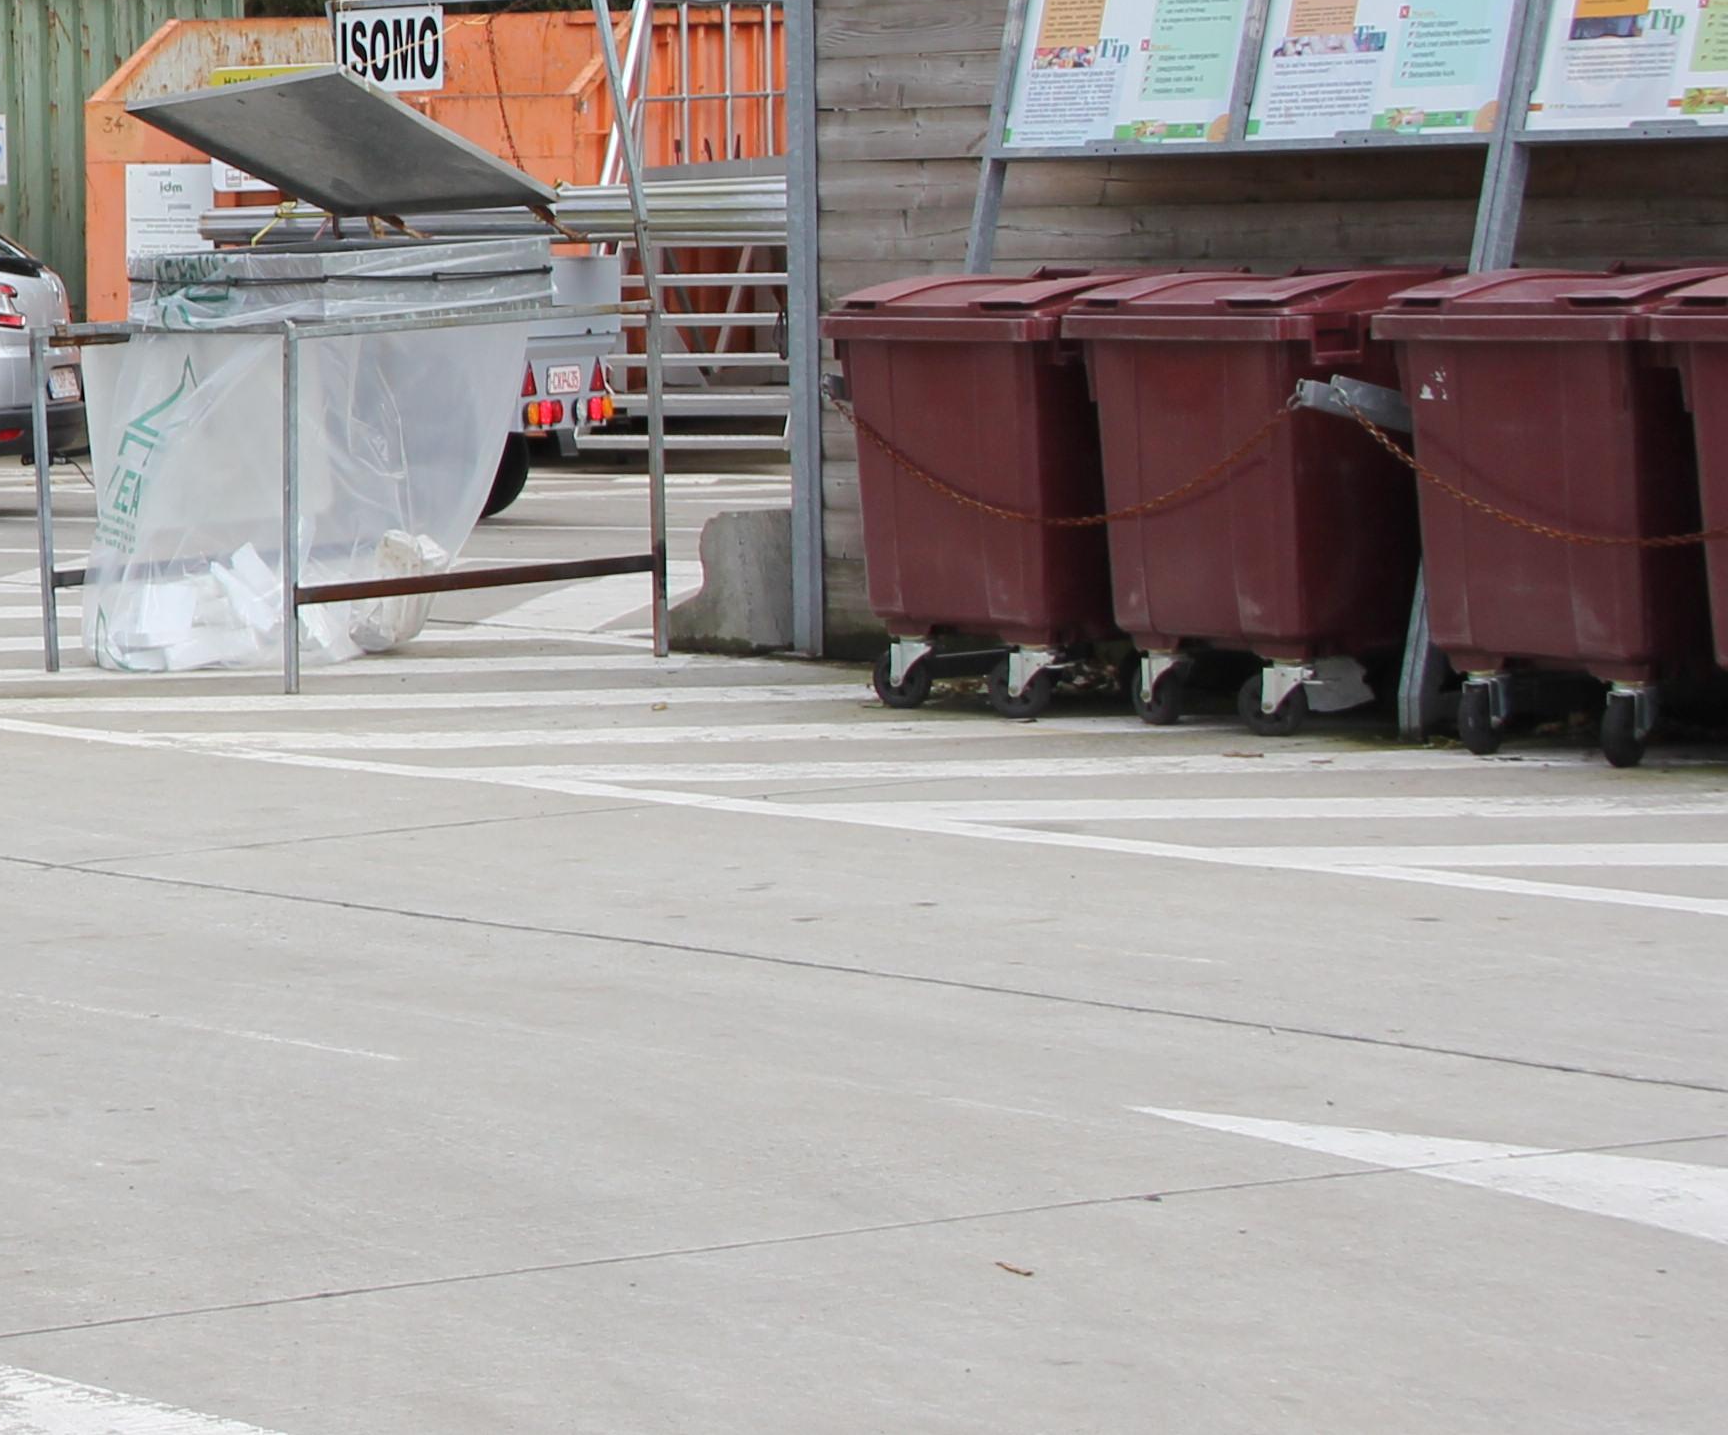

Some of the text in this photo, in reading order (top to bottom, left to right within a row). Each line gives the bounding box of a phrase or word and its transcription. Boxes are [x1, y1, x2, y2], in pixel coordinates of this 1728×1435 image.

[1648, 8, 1685, 35] Tip
[341, 16, 439, 82] ISOMO
[1098, 38, 1130, 63] Tip
[159, 180, 183, 194] idm
